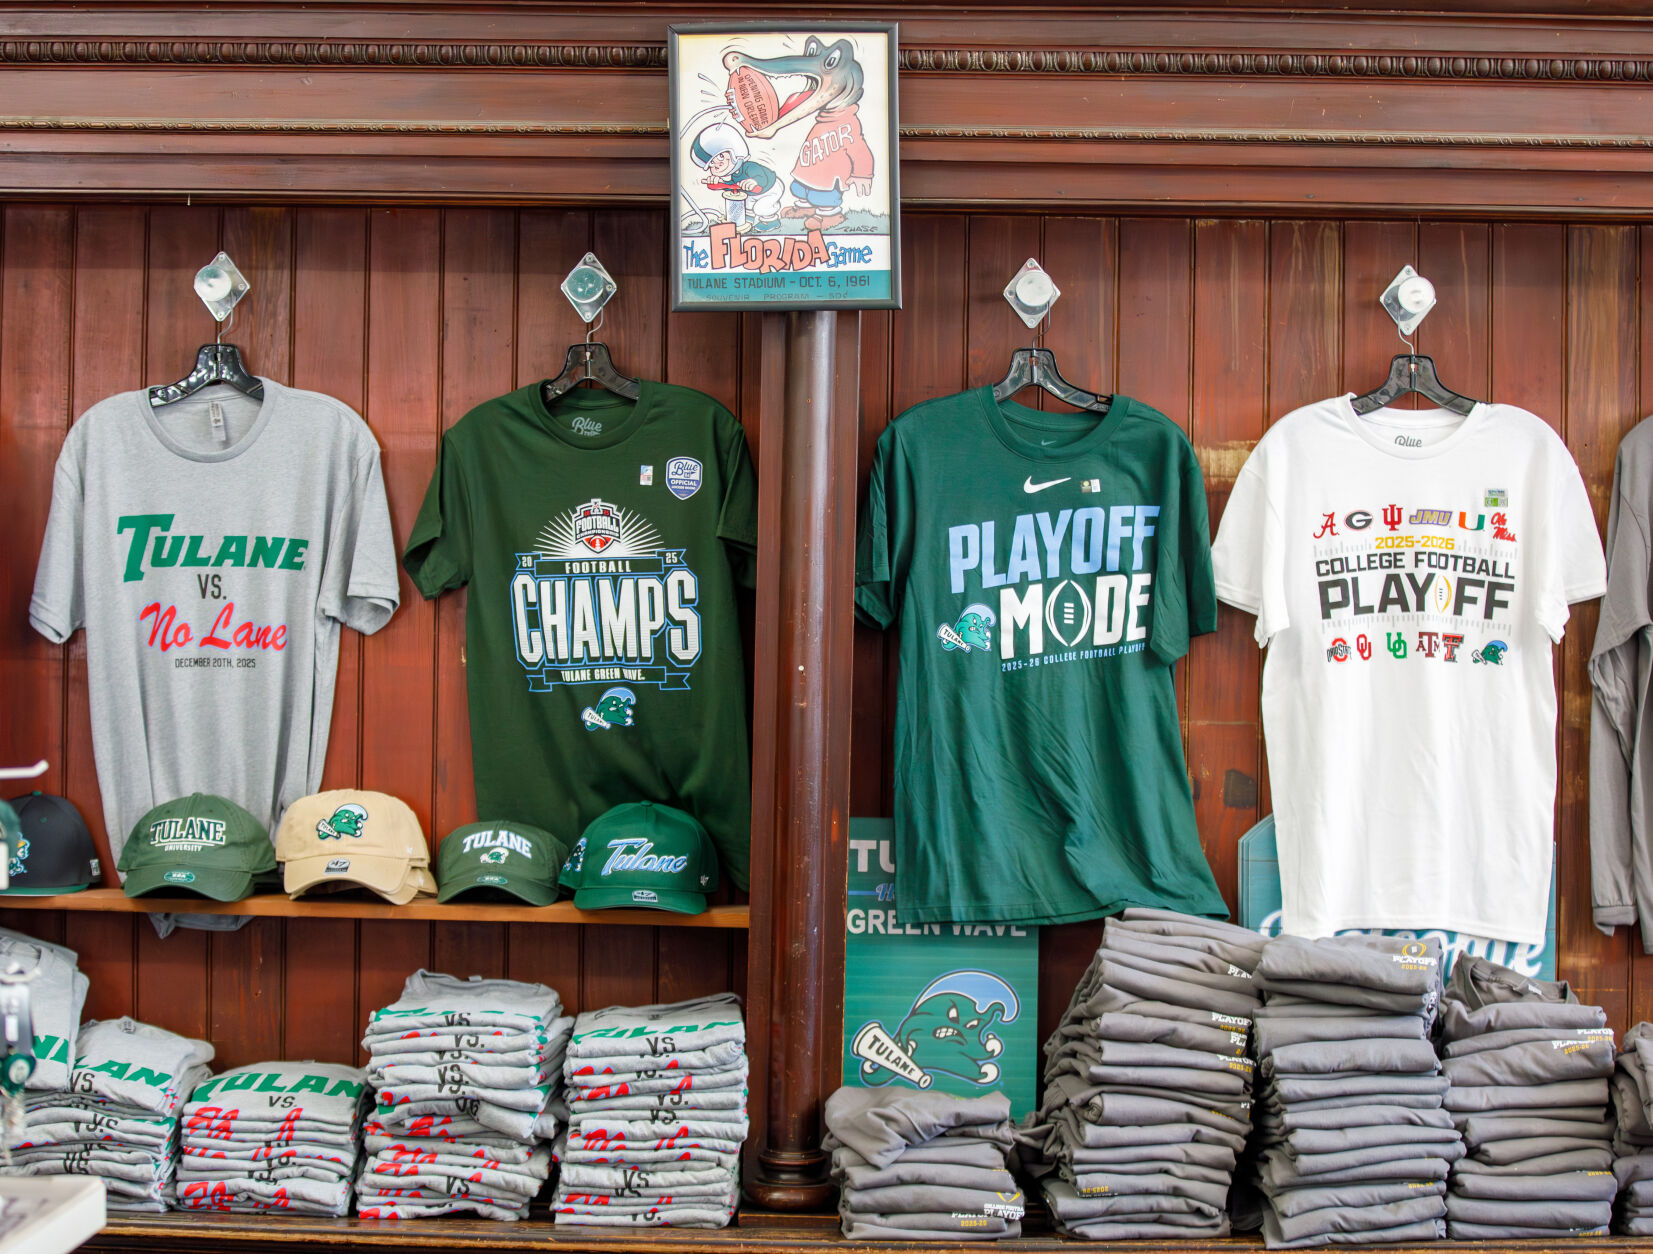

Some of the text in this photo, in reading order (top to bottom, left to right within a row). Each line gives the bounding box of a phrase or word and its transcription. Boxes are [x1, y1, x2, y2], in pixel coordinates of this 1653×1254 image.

[800, 123, 854, 167] GATOR
[683, 221, 873, 274] The FLORIDA Game
[688, 278, 728, 289] TULANE
[734, 277, 786, 289] STADIUM
[799, 276, 822, 288] OCT.
[828, 276, 841, 289] 6,
[846, 275, 870, 287] 1961
[571, 417, 602, 435] Blue
[671, 461, 698, 476] Blue
[575, 515, 620, 534] FOOTBALL
[1409, 509, 1453, 526] JMU
[1375, 536, 1455, 551] 2025-2026
[1493, 527, 1518, 542] Miss
[117, 514, 309, 583] TULANE
[665, 552, 678, 564] 25
[948, 505, 1161, 594] PLAYOFF
[522, 556, 532, 567] 20
[565, 560, 632, 573] FOOTBALL
[1315, 552, 1515, 579] COLLEGE FOOTBALL
[198, 574, 227, 600] VS.
[512, 569, 700, 664] CHAMPS
[139, 601, 288, 652] No Lane
[175, 658, 256, 669] DECEMBER 20TH, 2025
[1044, 651, 1077, 664] COLLEGE
[1080, 648, 1116, 660] FOOTBALL
[561, 670, 591, 682] TULANE
[594, 668, 620, 680] GREEN
[150, 817, 226, 845] TULANE
[165, 844, 202, 852] UNIVERSITY
[463, 830, 532, 859] TULANE
[601, 838, 687, 877] Tulane
[867, 1034, 916, 1077] TULANE
[69, 1071, 99, 1093] VS.
